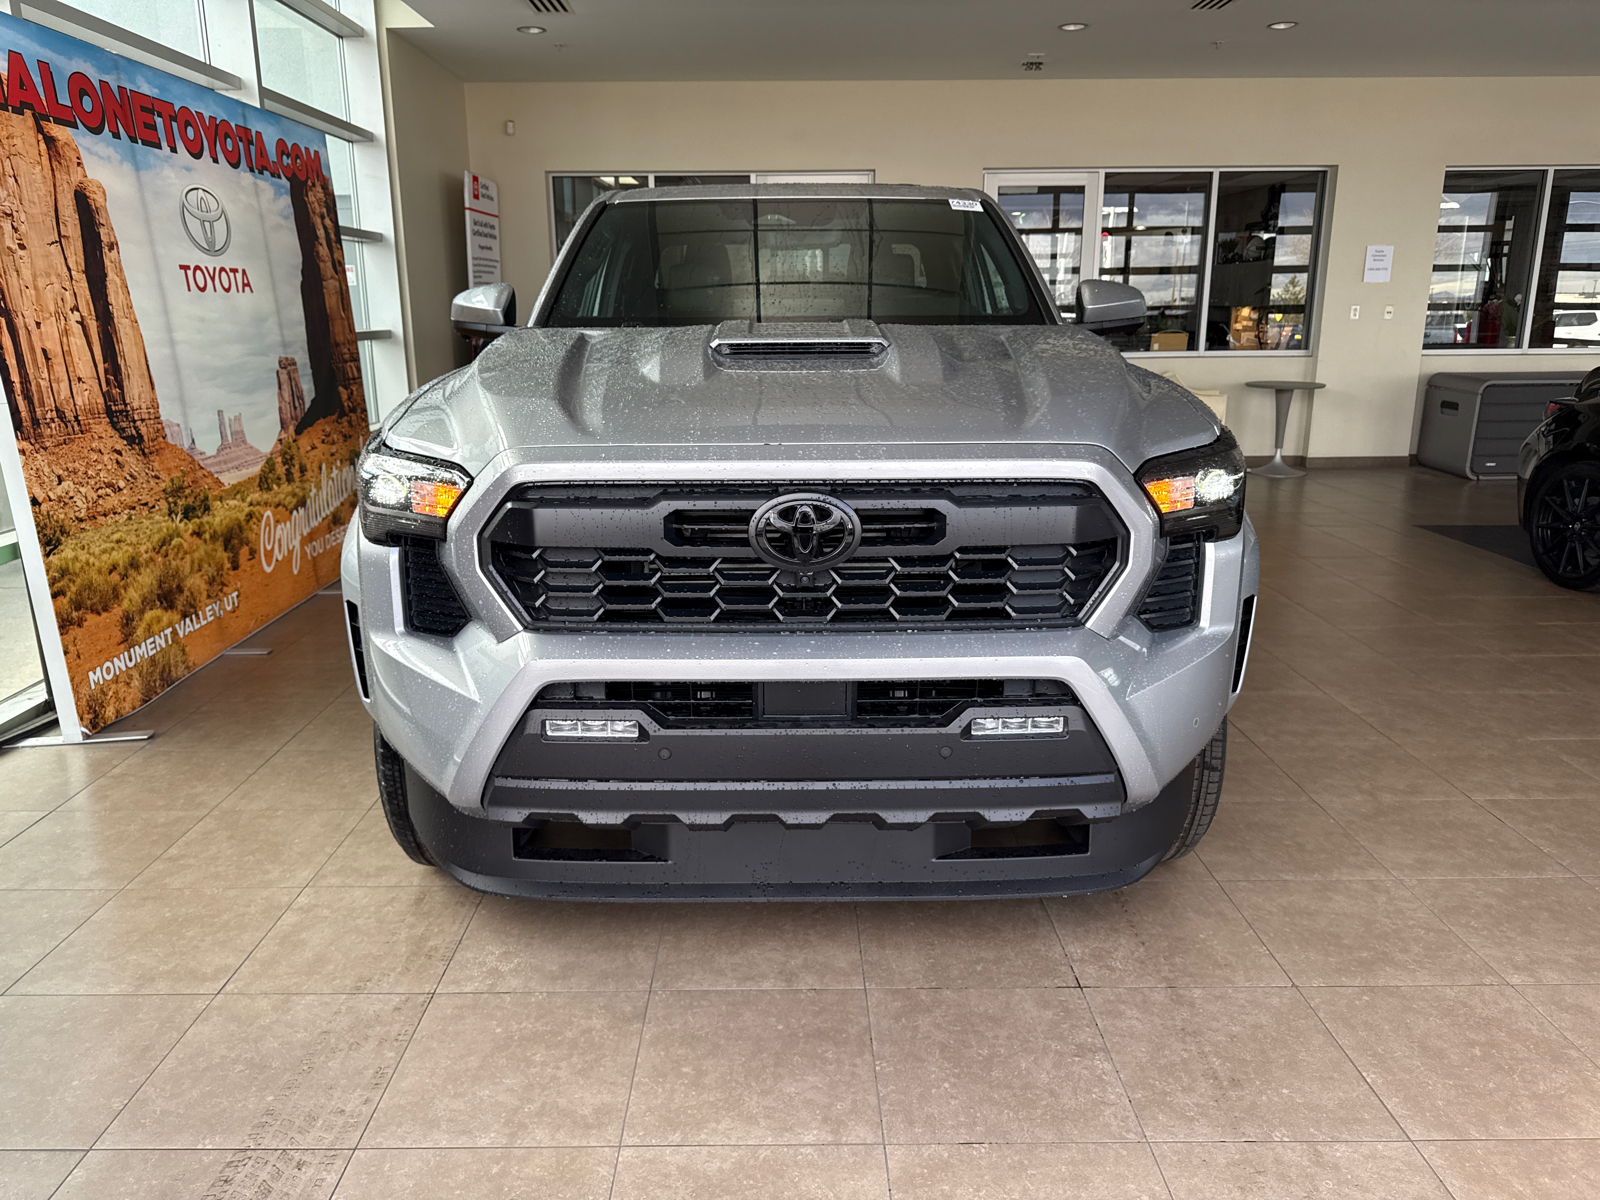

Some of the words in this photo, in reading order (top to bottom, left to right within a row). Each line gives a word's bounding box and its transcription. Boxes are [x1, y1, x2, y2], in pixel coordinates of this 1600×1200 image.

[0, 49, 325, 185] ALONETOYOTA.COM
[178, 264, 254, 294] TOYOTA
[304, 541, 324, 560] YOU
[325, 523, 348, 550] DESE
[88, 627, 173, 690] MONUMENT
[175, 600, 224, 639] VALLEY,
[224, 591, 239, 611] UT
